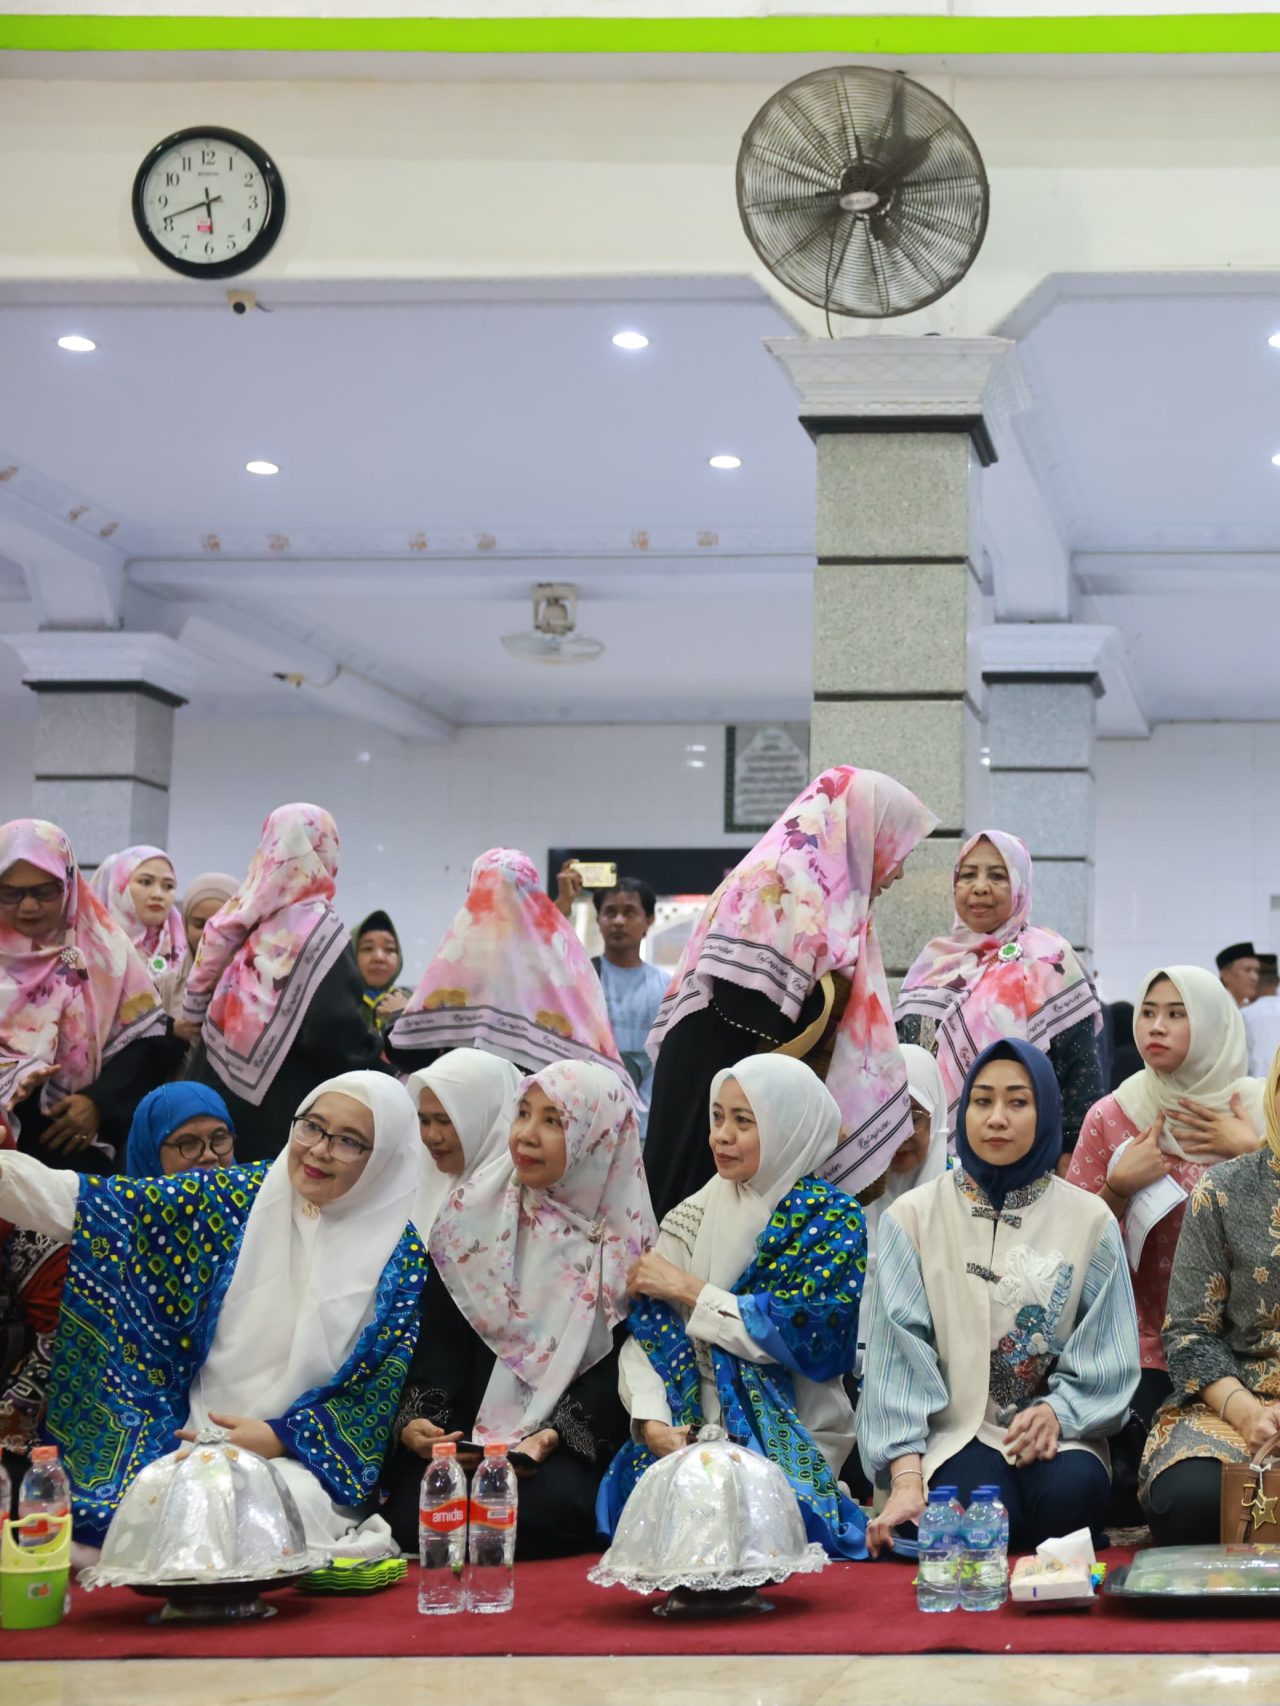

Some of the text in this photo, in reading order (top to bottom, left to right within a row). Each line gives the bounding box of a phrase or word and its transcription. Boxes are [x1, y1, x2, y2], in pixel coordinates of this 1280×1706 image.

[182, 157, 191, 171] 11
[201, 150, 216, 165] 12
[166, 172, 179, 186] 10
[244, 173, 253, 187] 2
[158, 195, 168, 209] 9
[249, 195, 258, 209] 3
[163, 218, 174, 232] 8
[242, 218, 251, 232] 4
[181, 234, 190, 250] 7
[204, 241, 214, 255] 6
[227, 234, 236, 249] 5
[432, 1508, 464, 1523] amidis
